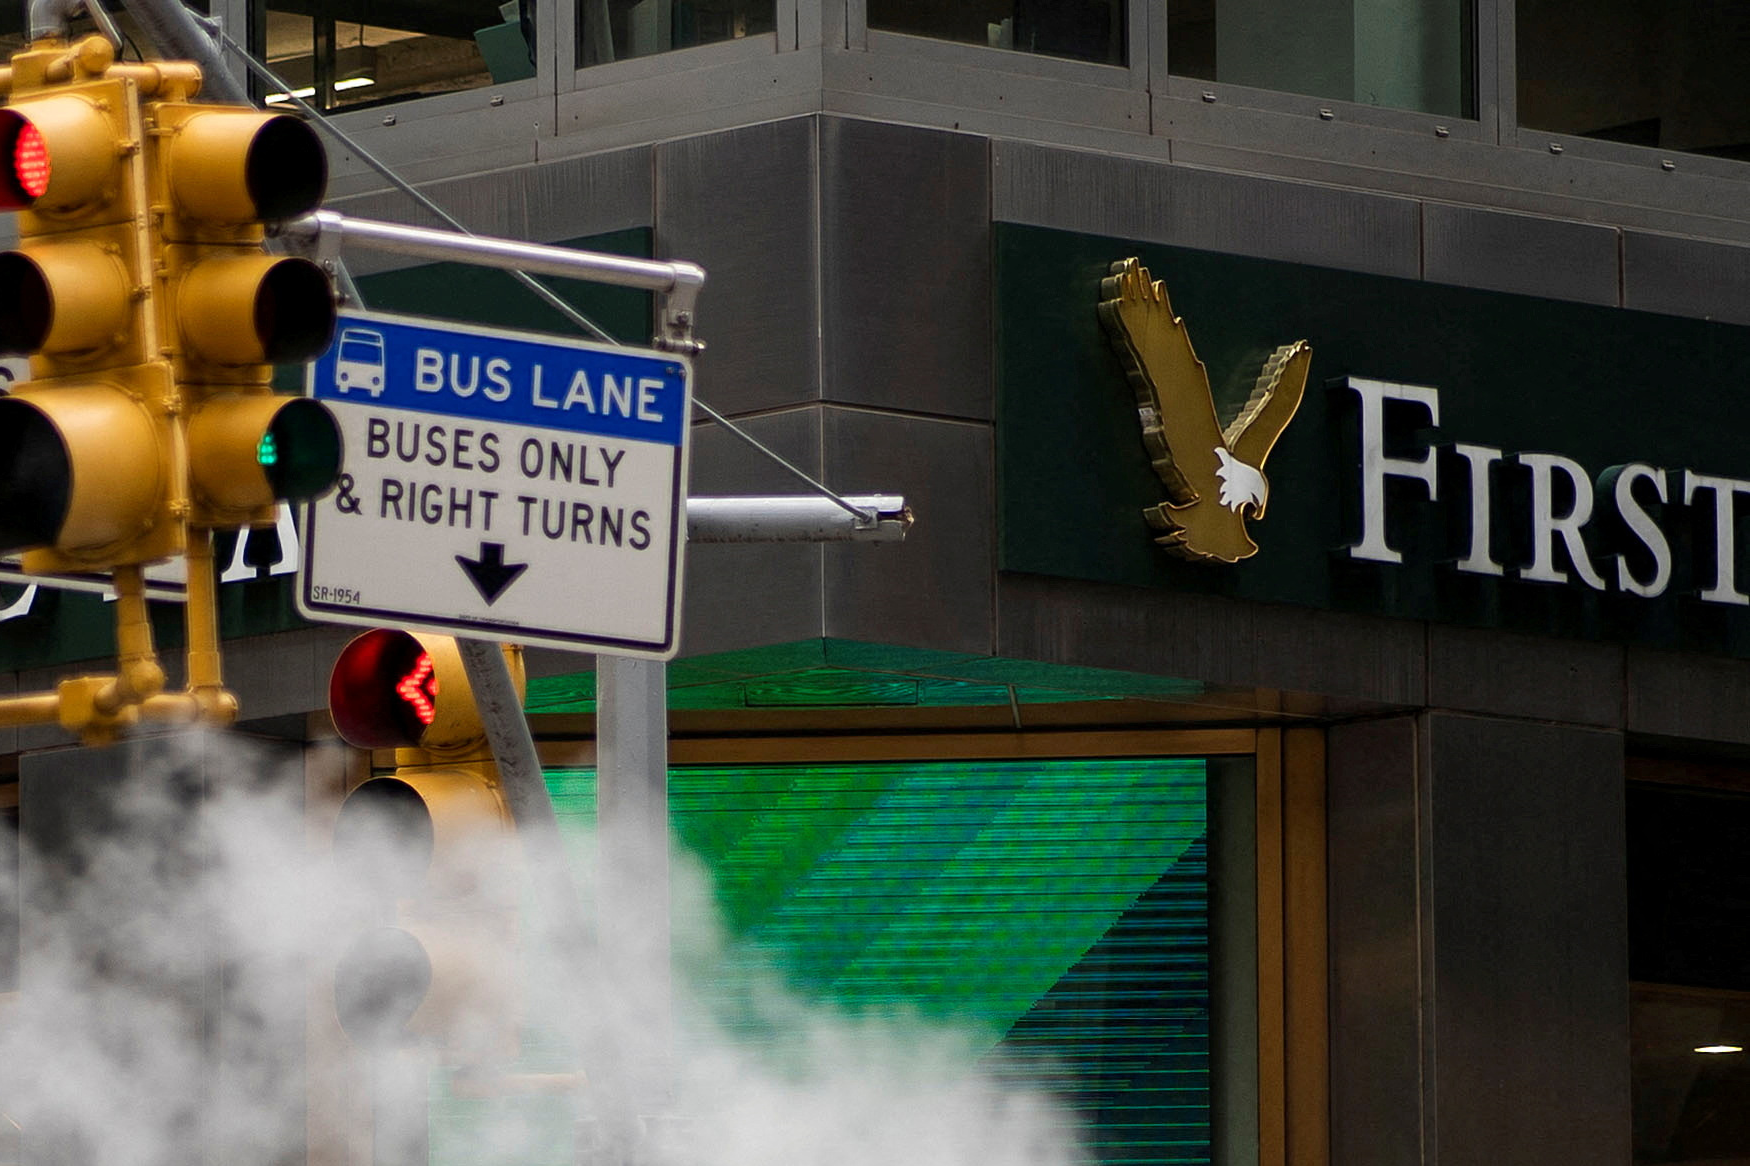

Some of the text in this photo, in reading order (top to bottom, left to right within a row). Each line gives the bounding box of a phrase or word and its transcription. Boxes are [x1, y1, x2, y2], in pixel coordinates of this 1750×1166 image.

[415, 348, 665, 423] BUS LANE
[367, 418, 626, 488] BUSES ONLY
[1347, 376, 1750, 605] FIRST
[335, 473, 651, 550] & RIGHT TURNS
[313, 585, 360, 605] SR-1954
